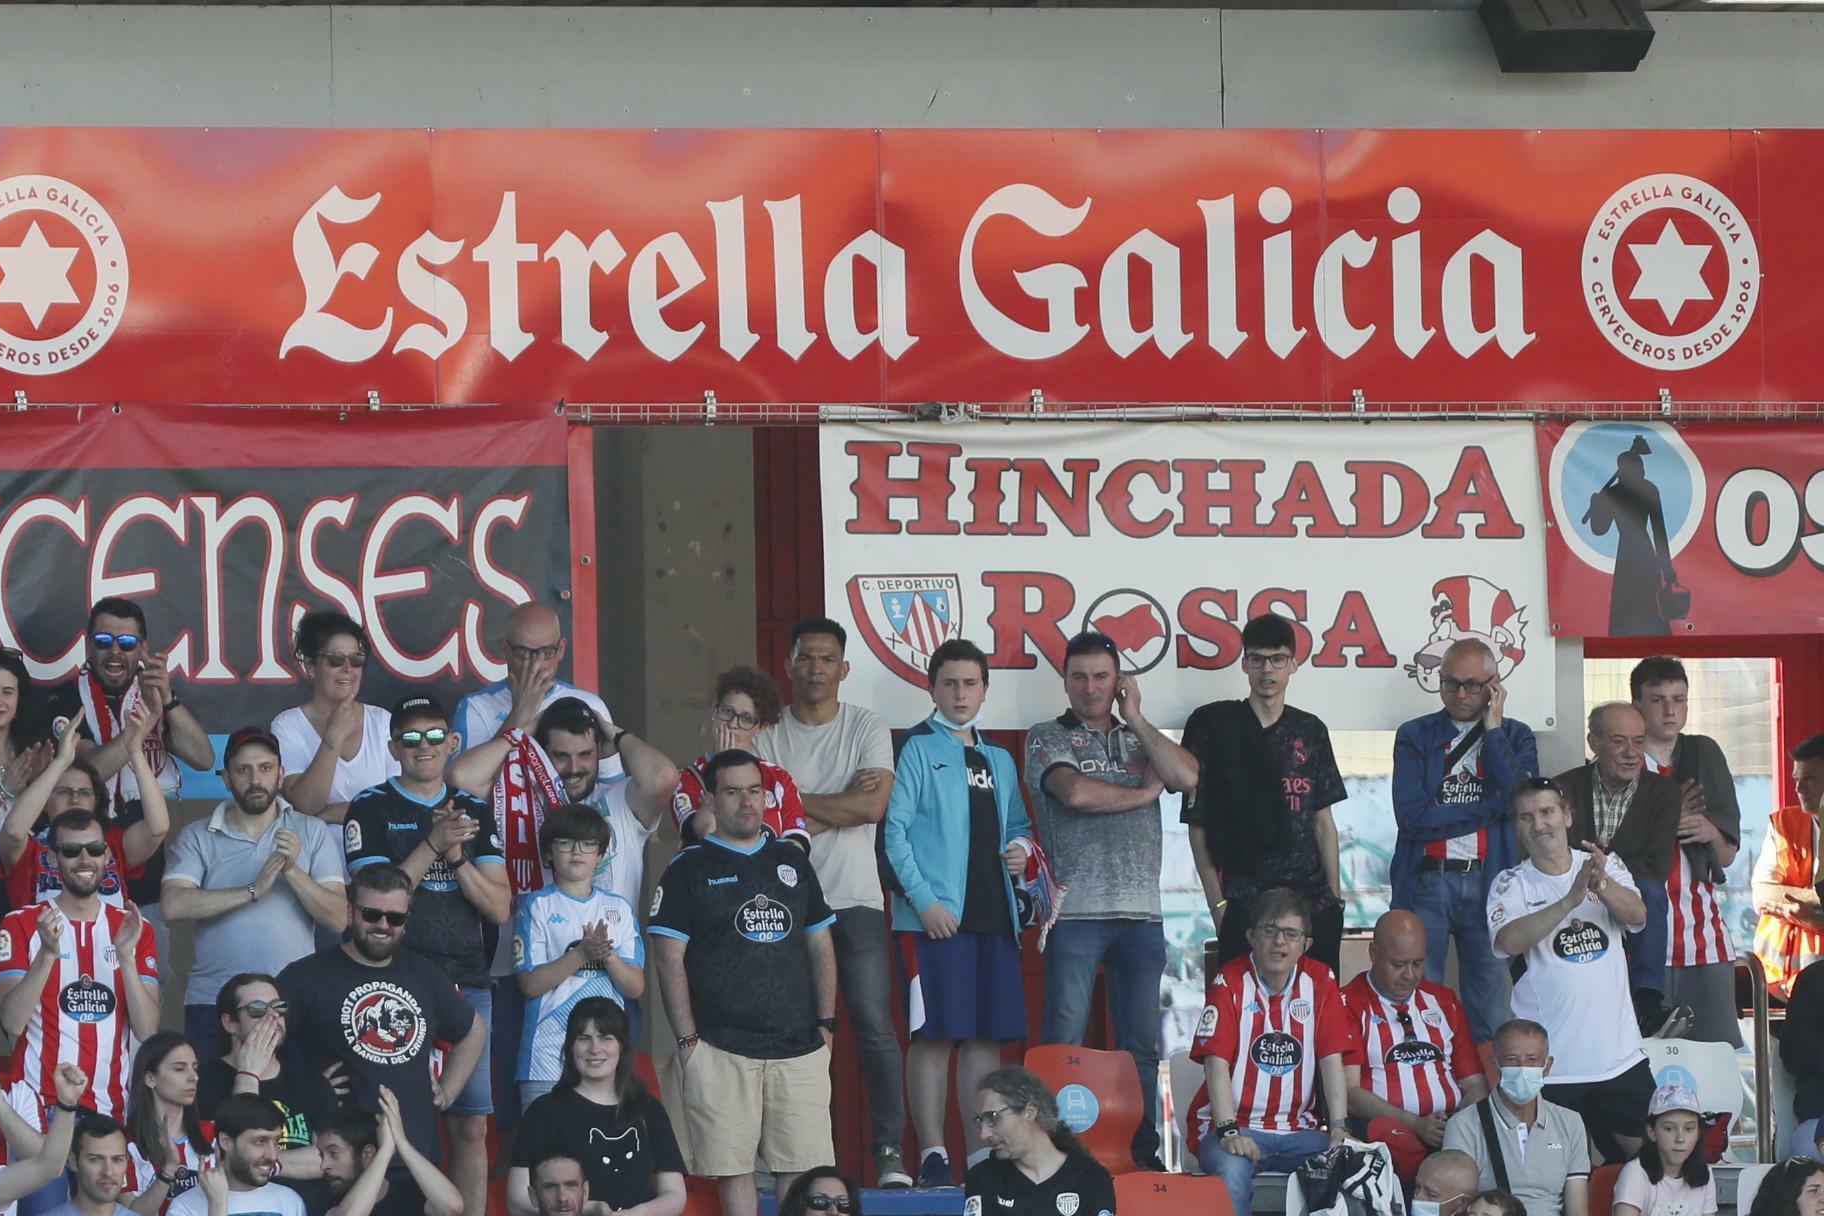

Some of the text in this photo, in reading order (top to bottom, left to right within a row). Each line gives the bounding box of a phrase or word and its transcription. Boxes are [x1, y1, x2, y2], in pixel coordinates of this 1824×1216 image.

[47, 188, 109, 246] GALICIA
[1598, 184, 1742, 244] ESTRELLA GALICIA
[279, 183, 1537, 363] Estrella Galicia
[48, 328, 99, 364] DESDE
[98, 283, 120, 327] 1906
[1591, 280, 1751, 361] CERVECEROS DESDE 1906
[844, 438, 1524, 539] HINCHADA
[1715, 467, 1824, 575] O
[878, 578, 955, 590] DEPORTIVO
[1443, 782, 1483, 793] Estrella
[743, 908, 785, 921] Estrella
[746, 919, 784, 932] Galicia
[1560, 932, 1602, 947] Estrella
[1563, 943, 1603, 956] Galicia
[66, 988, 108, 1002] Estrella
[68, 1000, 107, 1013] Galicia
[341, 981, 422, 1025] RIOT PROPAGANDA
[344, 1029, 356, 1045] LA
[352, 1043, 389, 1064] BANDA
[391, 1054, 411, 1065] DEL
[409, 1018, 427, 1058] CRIMEN
[1666, 1046, 1679, 1056] 30
[1153, 1184, 1167, 1192] 34
